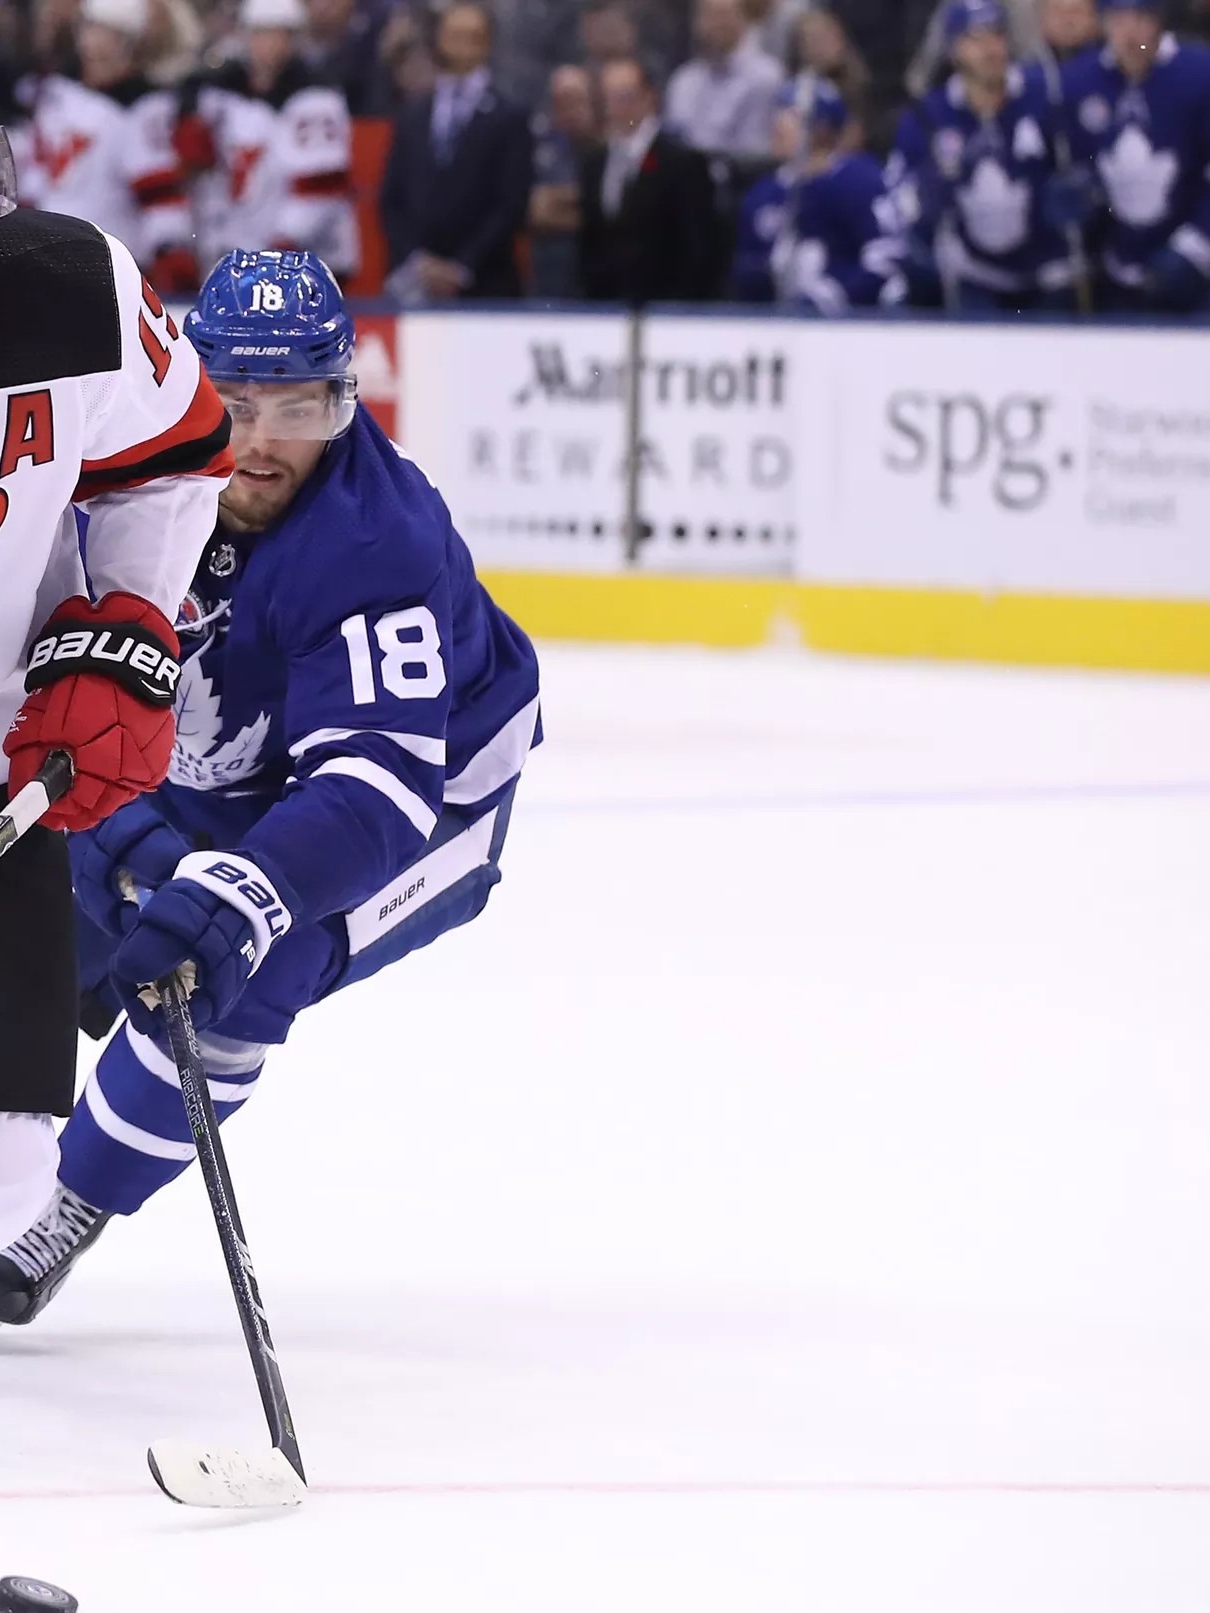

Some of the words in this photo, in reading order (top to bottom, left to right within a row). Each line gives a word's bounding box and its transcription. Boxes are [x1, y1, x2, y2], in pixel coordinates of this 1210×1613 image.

[249, 283, 284, 312] 18
[230, 346, 290, 356] BAUER
[27, 630, 181, 691] BAUER
[341, 605, 447, 705] 18
[378, 876, 426, 922] BAUER
[180, 1067, 205, 1139] RIBCORE
